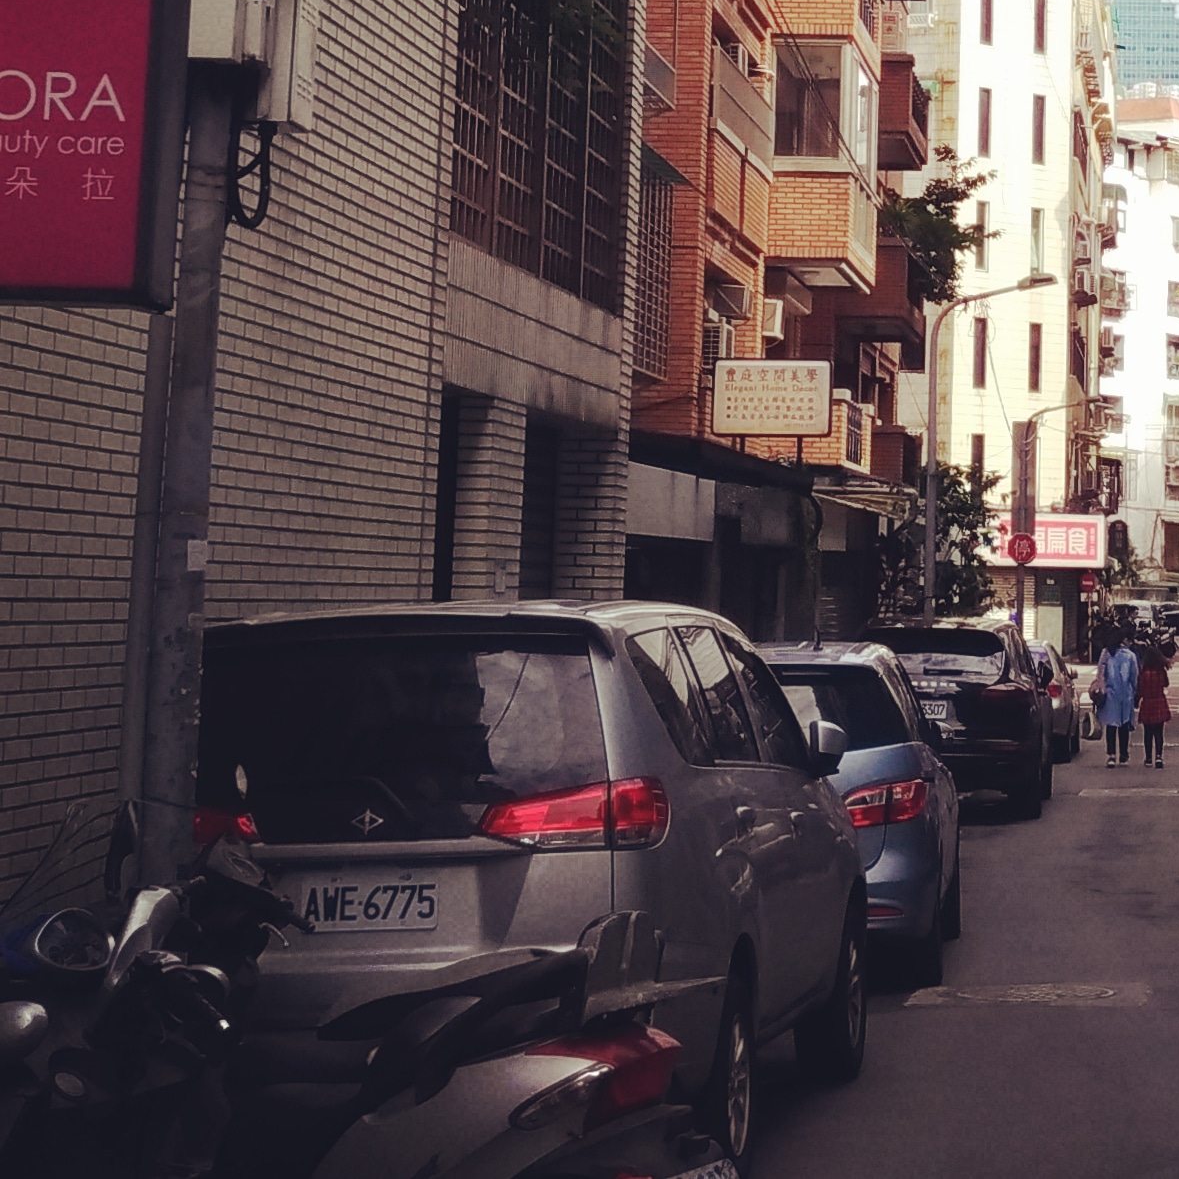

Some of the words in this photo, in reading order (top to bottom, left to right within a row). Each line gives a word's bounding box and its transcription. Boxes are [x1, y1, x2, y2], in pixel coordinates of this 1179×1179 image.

[0, 129, 49, 159] uty
[57, 135, 125, 155] care
[724, 383, 757, 393] Elegant
[761, 383, 788, 392] Home
[1013, 538, 1031, 557] 停
